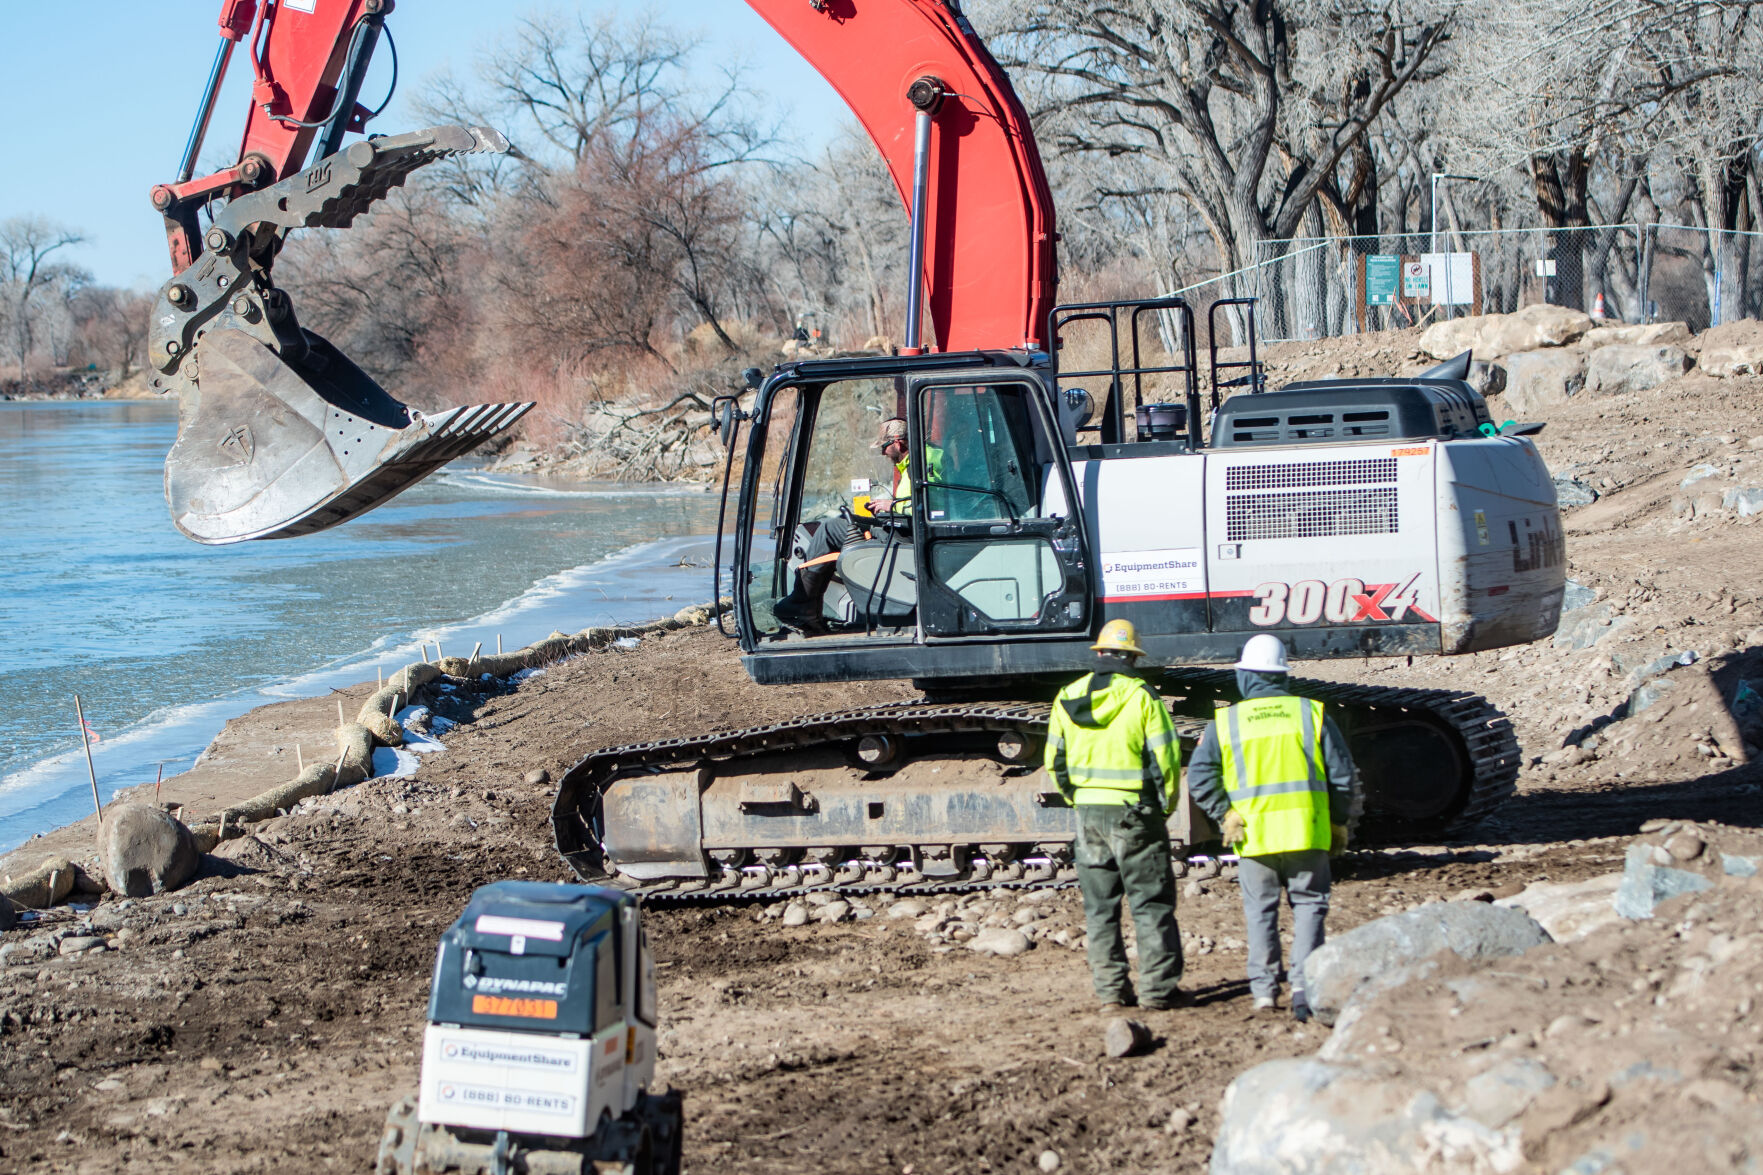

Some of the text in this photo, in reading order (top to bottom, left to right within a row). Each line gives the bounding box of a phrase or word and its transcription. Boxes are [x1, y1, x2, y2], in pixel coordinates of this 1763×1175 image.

[1114, 560, 1198, 573] EquipmentShare
[1143, 581, 1188, 591] 80-RENTS
[479, 976, 567, 995] DYNAPAC
[461, 1046, 571, 1067] EquipmentShare
